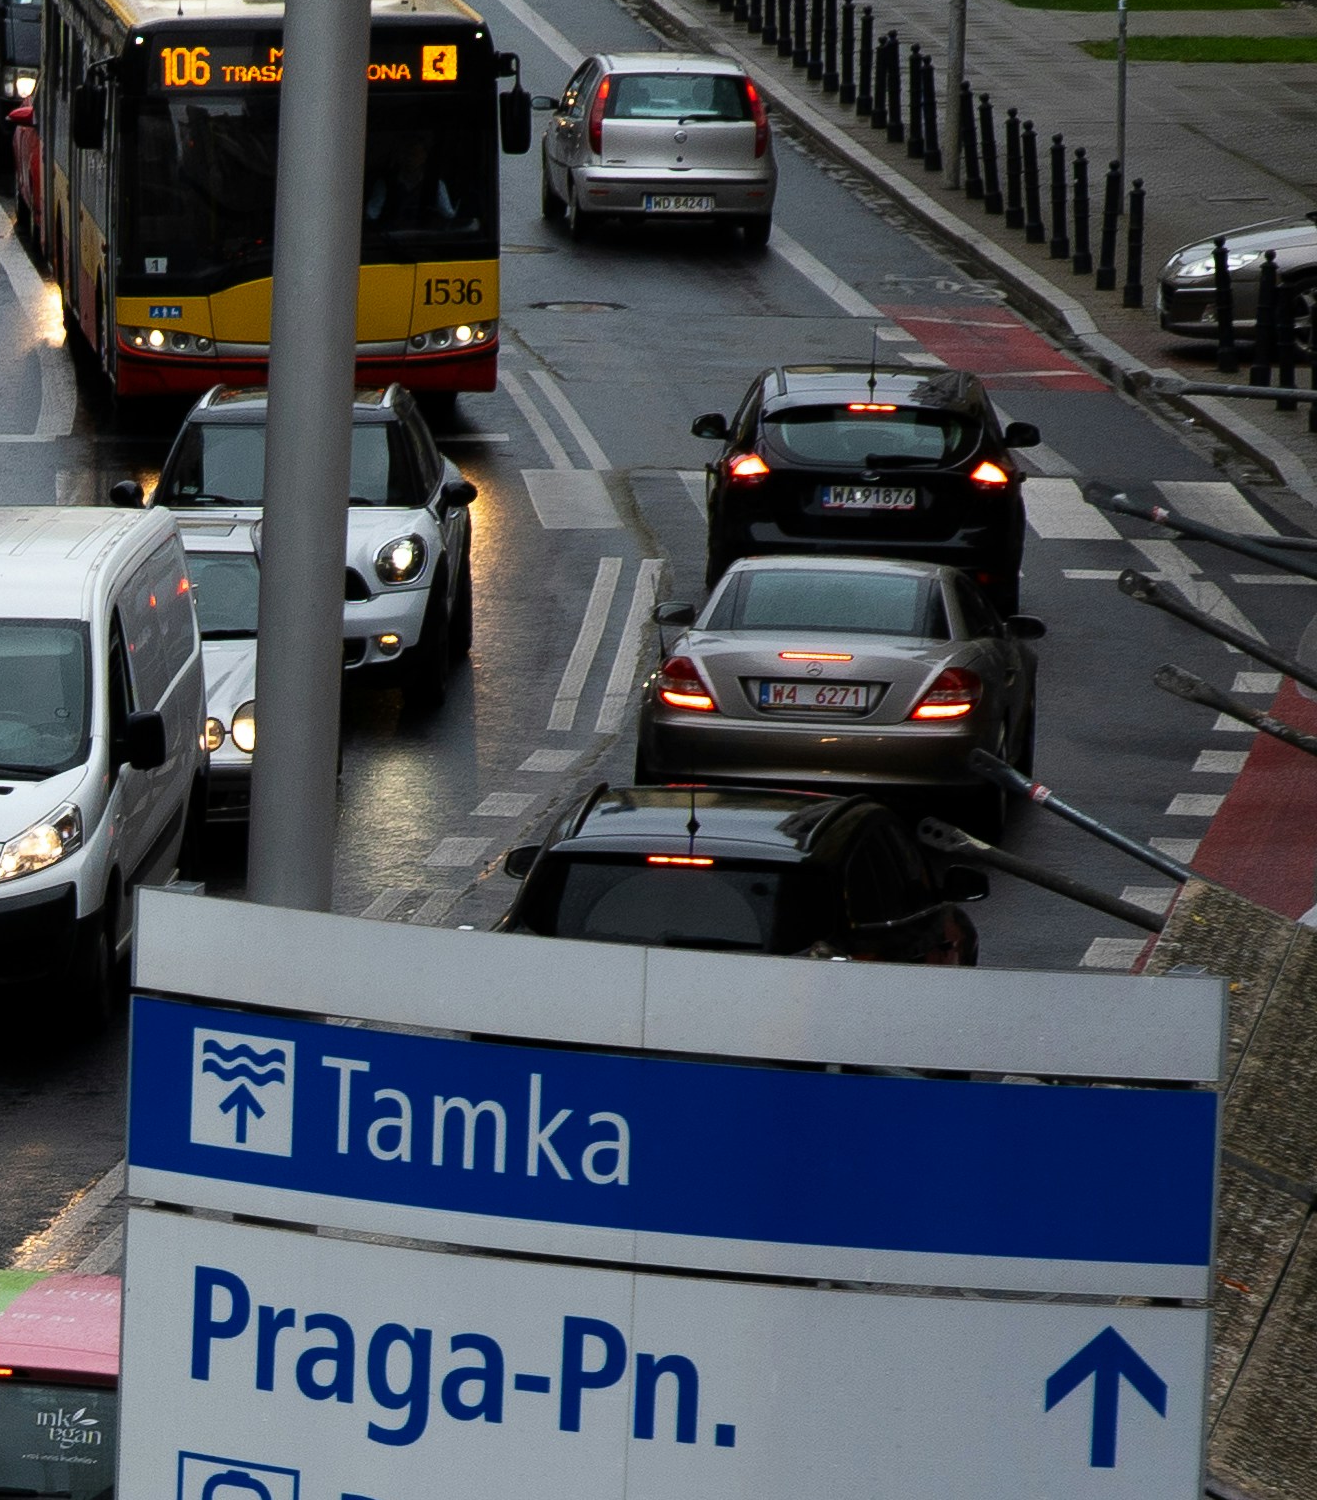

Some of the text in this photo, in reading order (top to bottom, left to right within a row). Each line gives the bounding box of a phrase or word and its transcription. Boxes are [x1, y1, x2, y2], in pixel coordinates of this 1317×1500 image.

[161, 46, 211, 86] 106
[653, 196, 671, 209] WD
[423, 278, 483, 305] 1536
[832, 486, 914, 505] WA 91876
[773, 686, 860, 706] W4 6271
[321, 1054, 633, 1187] Tamka
[190, 1265, 738, 1447] Praga-Pn.
